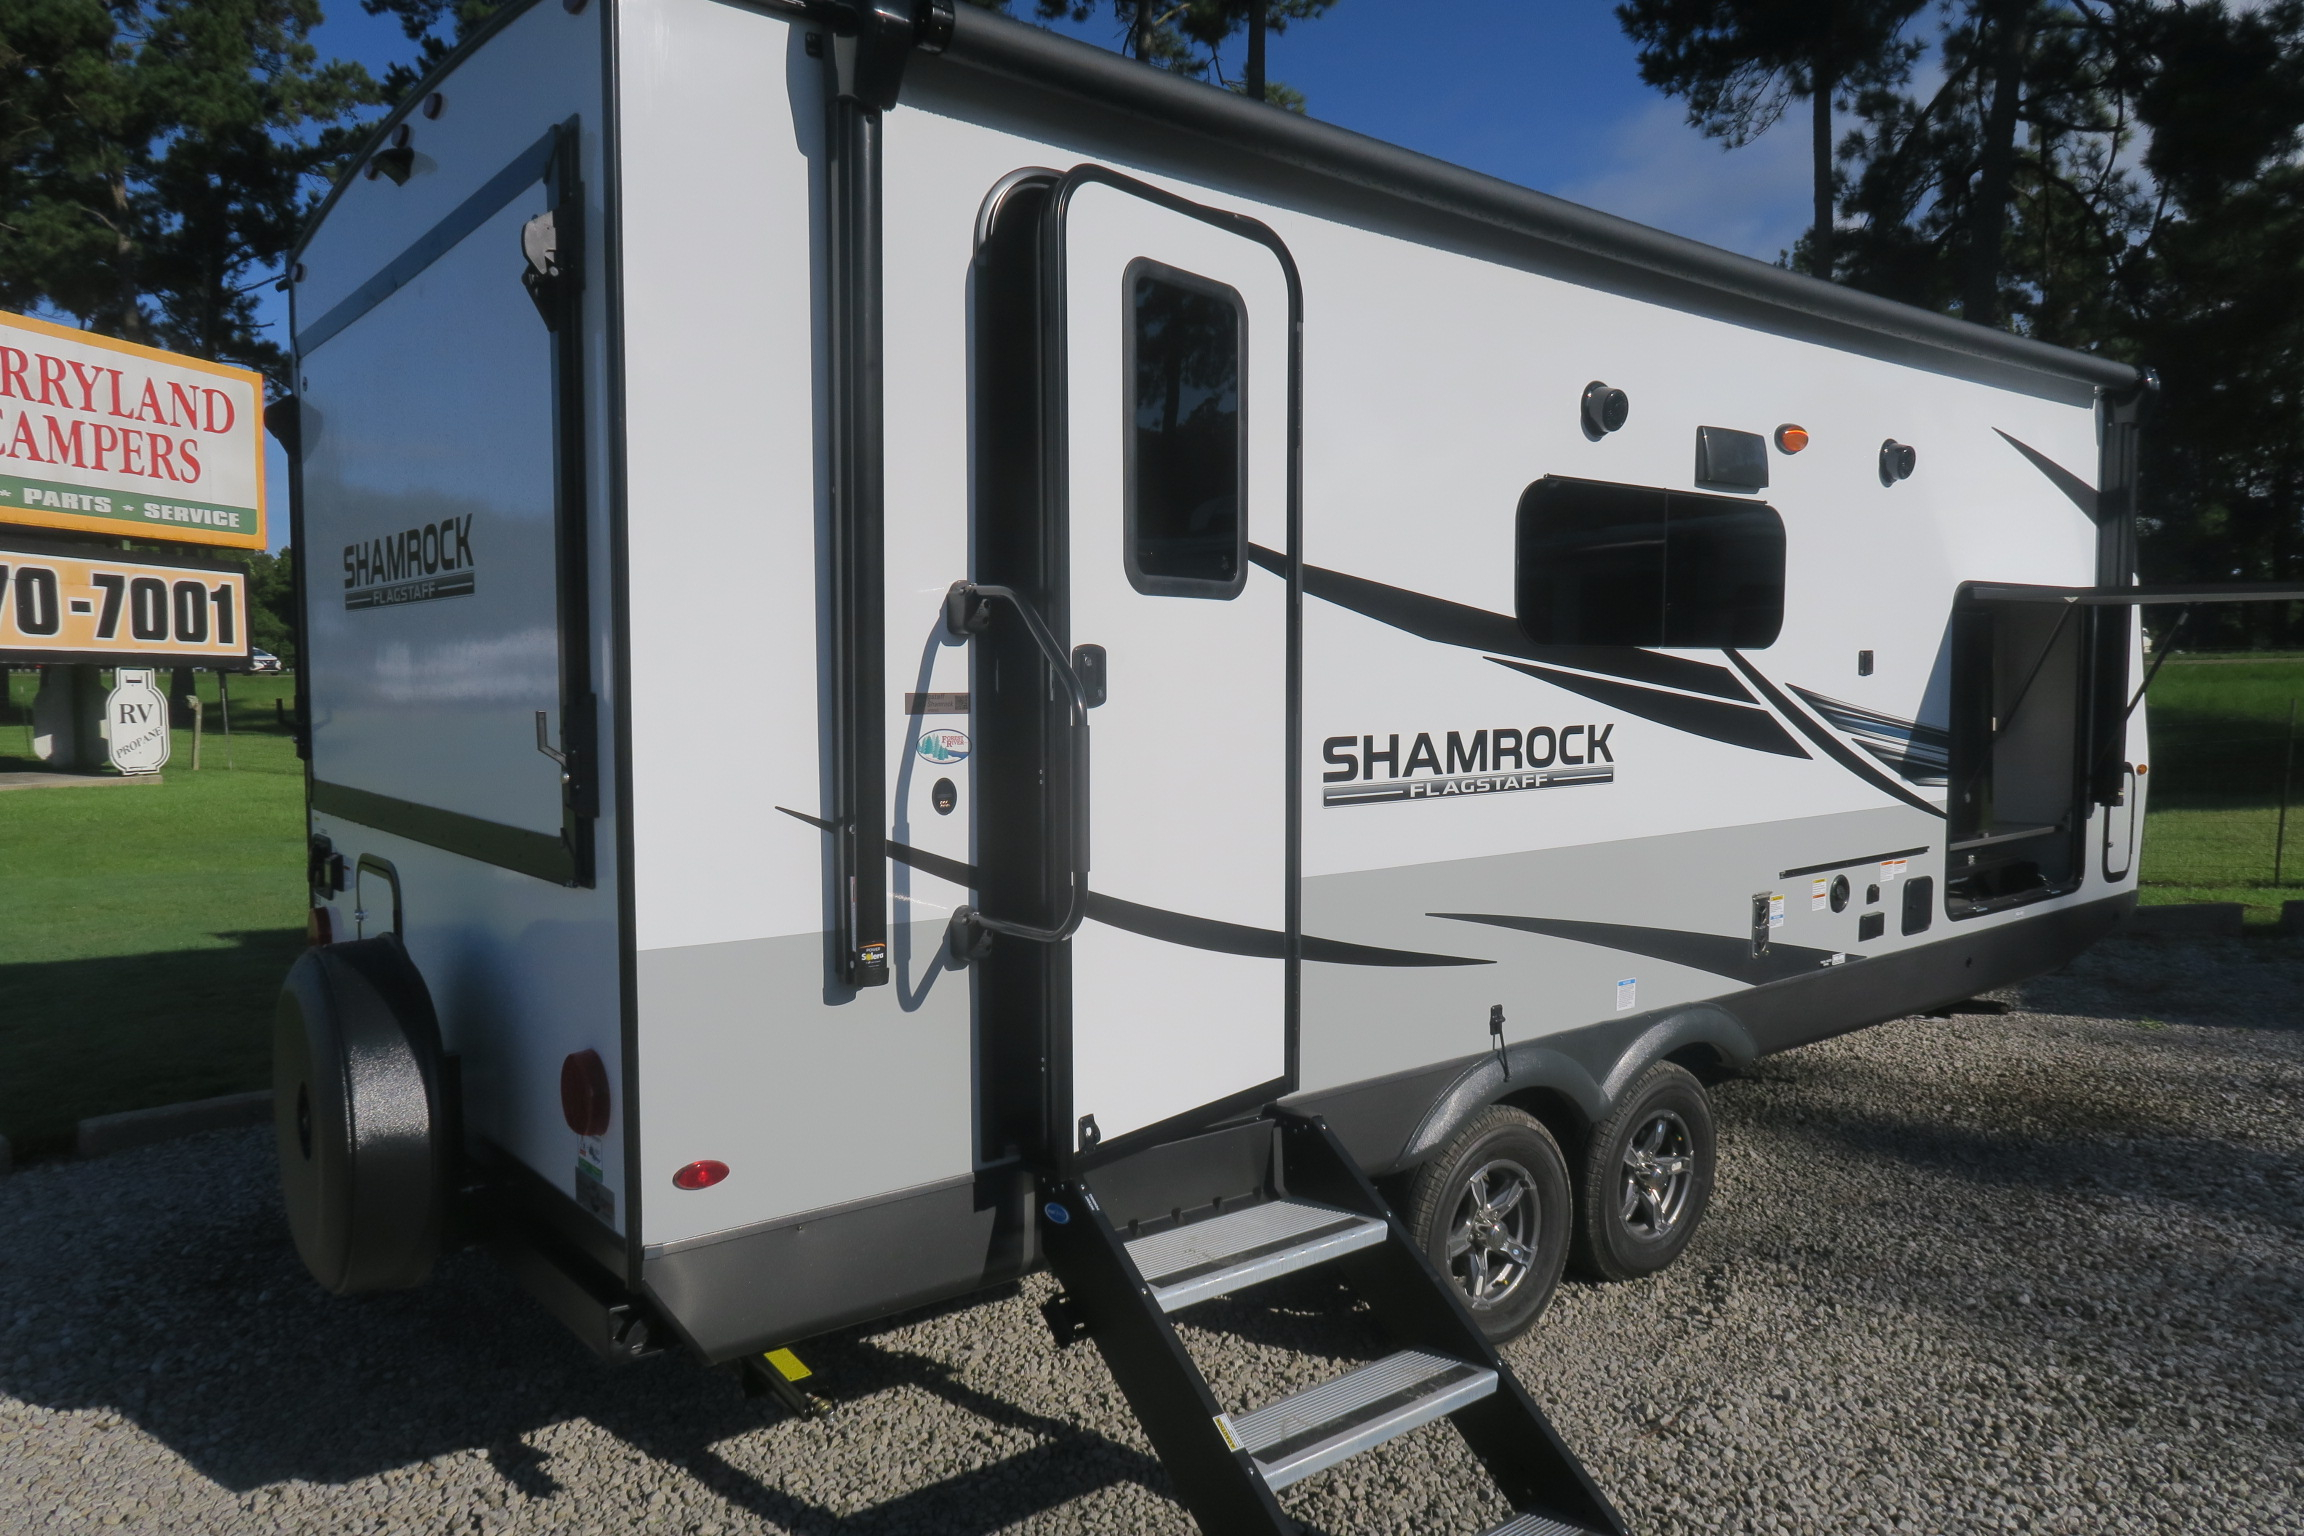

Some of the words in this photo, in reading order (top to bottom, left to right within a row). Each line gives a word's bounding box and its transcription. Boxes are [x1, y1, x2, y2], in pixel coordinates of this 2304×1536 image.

[0, 409, 201, 484] AMPERS
[23, 487, 112, 513] PARTS
[144, 502, 240, 528] SERVICE
[344, 513, 474, 589] SHAMROCK
[373, 581, 436, 605] FLAGSTAFF
[119, 703, 153, 723] RV
[116, 726, 163, 758] PROPANE
[1322, 723, 1615, 783] SHAMROCK
[1410, 773, 1548, 798] FLAGSTAFF
